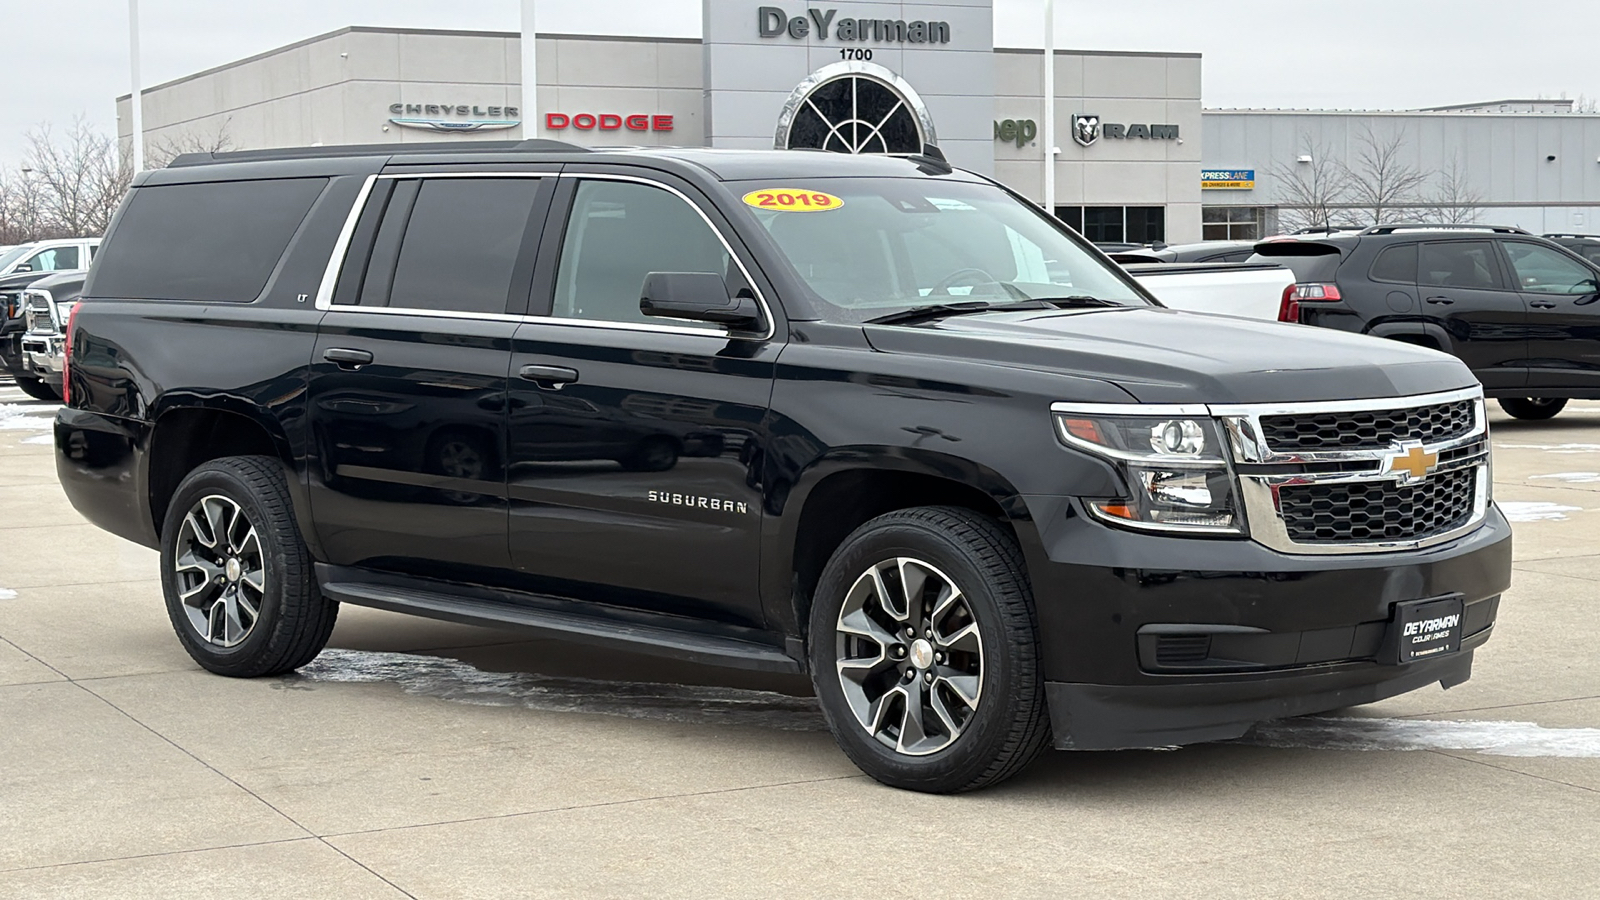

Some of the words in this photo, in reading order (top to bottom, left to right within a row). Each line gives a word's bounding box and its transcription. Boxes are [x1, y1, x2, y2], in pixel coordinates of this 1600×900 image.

[758, 6, 950, 44] DeYarman
[839, 48, 873, 60] 1700
[389, 103, 519, 117] CHRYSLER
[545, 112, 674, 131] DODGE
[1103, 123, 1180, 139] RAM
[757, 193, 831, 207] 2019
[297, 293, 309, 303] LT
[648, 490, 747, 514] SUBURBAN
[1403, 614, 1459, 636] DEYARMAN
